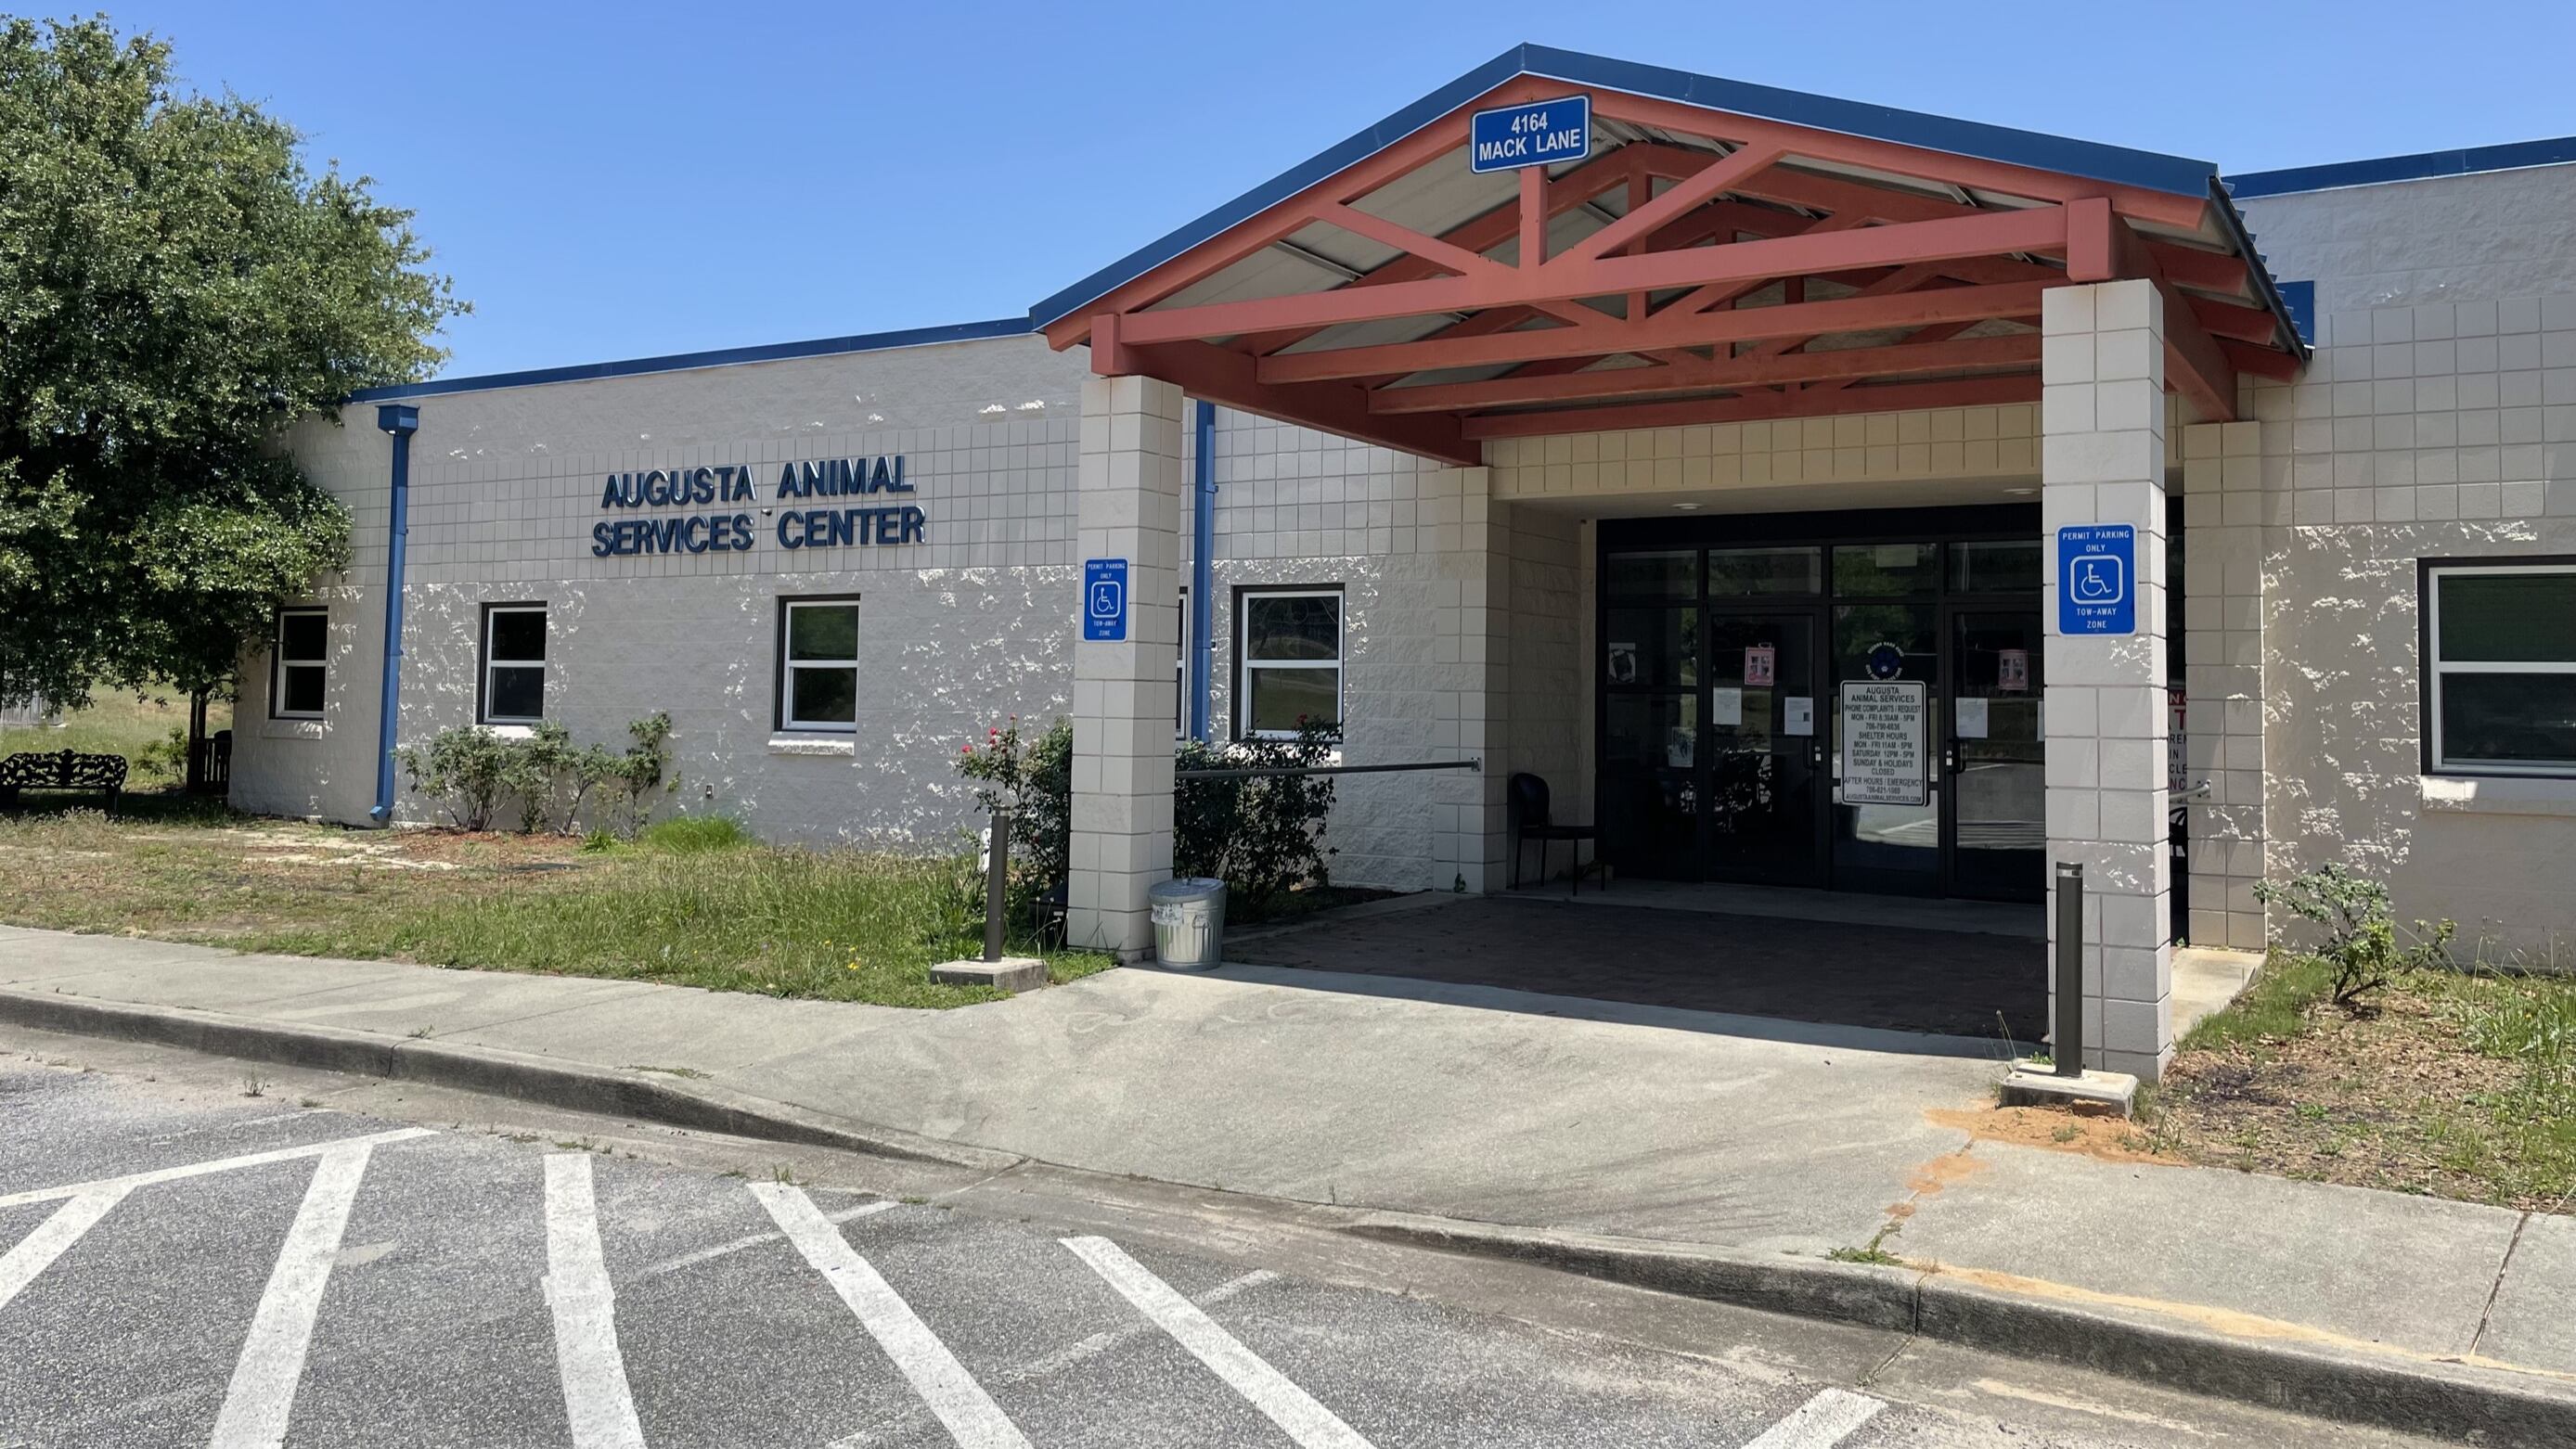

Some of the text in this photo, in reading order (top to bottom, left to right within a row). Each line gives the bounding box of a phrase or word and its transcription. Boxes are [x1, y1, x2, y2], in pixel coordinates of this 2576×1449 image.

[1512, 111, 1548, 134] 4164
[1479, 128, 1580, 161] MACK LANE
[601, 455, 917, 508] AUGUSTA ANIMAL
[592, 506, 926, 557] SERVICES CENTER
[2062, 530, 2130, 540] PERMIT PARKING
[2085, 544, 2106, 552] ONLY
[2076, 608, 2117, 616] TOW-AWAY
[2086, 620, 2107, 629] ZONE
[1879, 695, 1915, 703] SERVICES
[1887, 732, 1908, 740] HOURS
[1884, 759, 1913, 767] HOLIDAYS
[1887, 778, 1923, 787] EMERGENCY
